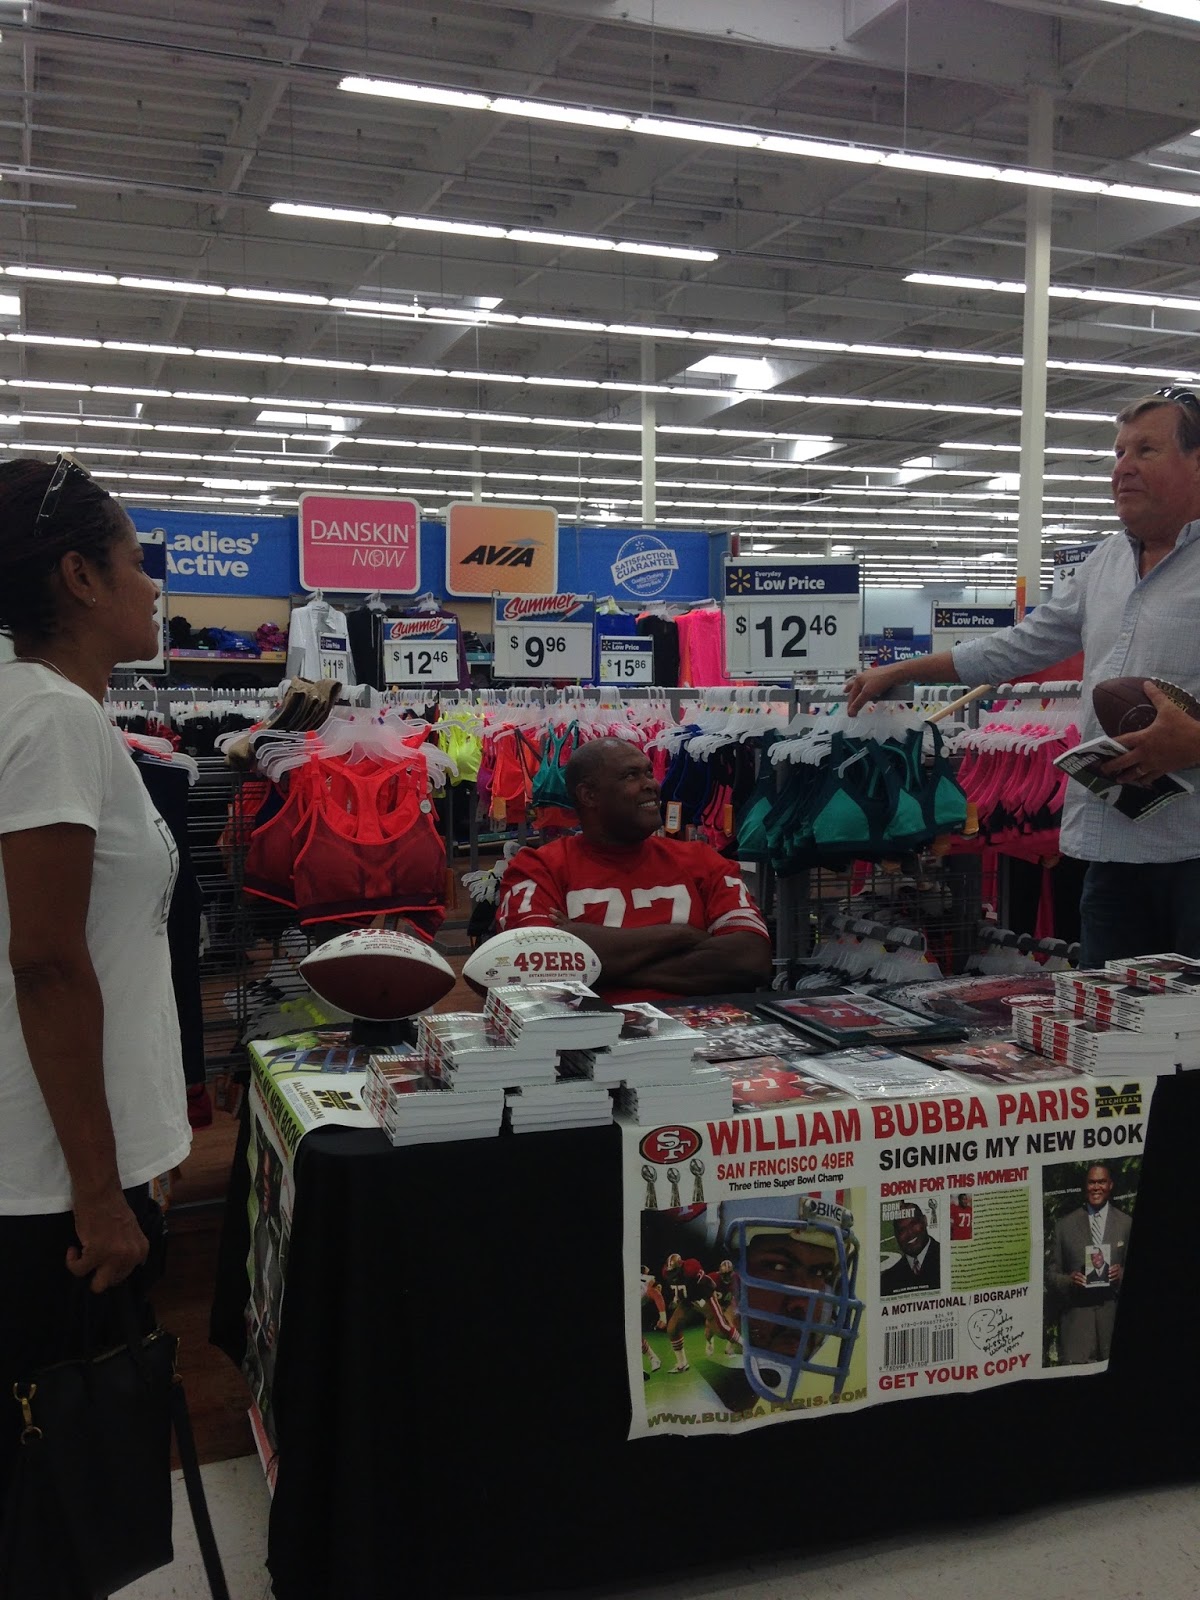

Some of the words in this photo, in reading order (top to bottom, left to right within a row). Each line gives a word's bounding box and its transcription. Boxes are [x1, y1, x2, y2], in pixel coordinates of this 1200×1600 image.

[311, 520, 409, 544] DANSKIN
[166, 552, 249, 577] Active
[352, 549, 406, 568] NOW
[460, 545, 535, 567] AVIA
[614, 552, 673, 573] SATISFACTION
[616, 558, 675, 580] GUARANTEE
[755, 577, 786, 590] Low
[788, 576, 825, 590] Price
[505, 594, 575, 619] Summer
[391, 617, 442, 640] Summer
[952, 616, 971, 625] Low
[972, 616, 994, 625] Price
[510, 636, 519, 650] $
[736, 615, 747, 636] $
[756, 615, 807, 658] 12
[393, 651, 400, 662] $
[404, 651, 432, 675] 12
[614, 659, 635, 677] 15
[566, 884, 692, 928] 77
[514, 952, 586, 972] 49ERS
[292, 1081, 326, 1120] ALL-AMERICAN
[1097, 1096, 1140, 1106] MICHIGAN
[707, 1109, 861, 1157] WILLIAM
[872, 1097, 989, 1140] BUBBA
[997, 1086, 1089, 1127] PARIS
[879, 1140, 978, 1171] SIGNING
[985, 1135, 1020, 1159] MY
[1027, 1130, 1076, 1154] NEW
[1083, 1123, 1143, 1149] BOOK
[717, 1163, 745, 1181] SAN
[750, 1154, 817, 1178] FRNCISCO
[822, 1151, 854, 1170] 49ER
[729, 1181, 752, 1192] Three
[753, 1179, 771, 1189] time
[773, 1177, 795, 1190] Super
[797, 1175, 816, 1185] Bowl
[818, 1173, 844, 1185] Champ
[880, 1179, 917, 1198] BORN
[919, 1176, 945, 1193] FOR
[947, 1173, 975, 1189] THIS
[977, 1166, 1030, 1186] MOMENT
[818, 1201, 842, 1221] BIKE
[882, 1202, 900, 1212] BORN
[882, 1208, 916, 1222] MOMENT
[881, 1306, 889, 1316] A
[892, 1296, 966, 1316] MOTIVATIONAL
[974, 1287, 1030, 1305] BIOGRAPHY
[879, 1372, 918, 1390] GET
[924, 1365, 978, 1385] YOUR
[984, 1353, 1031, 1377] COPY
